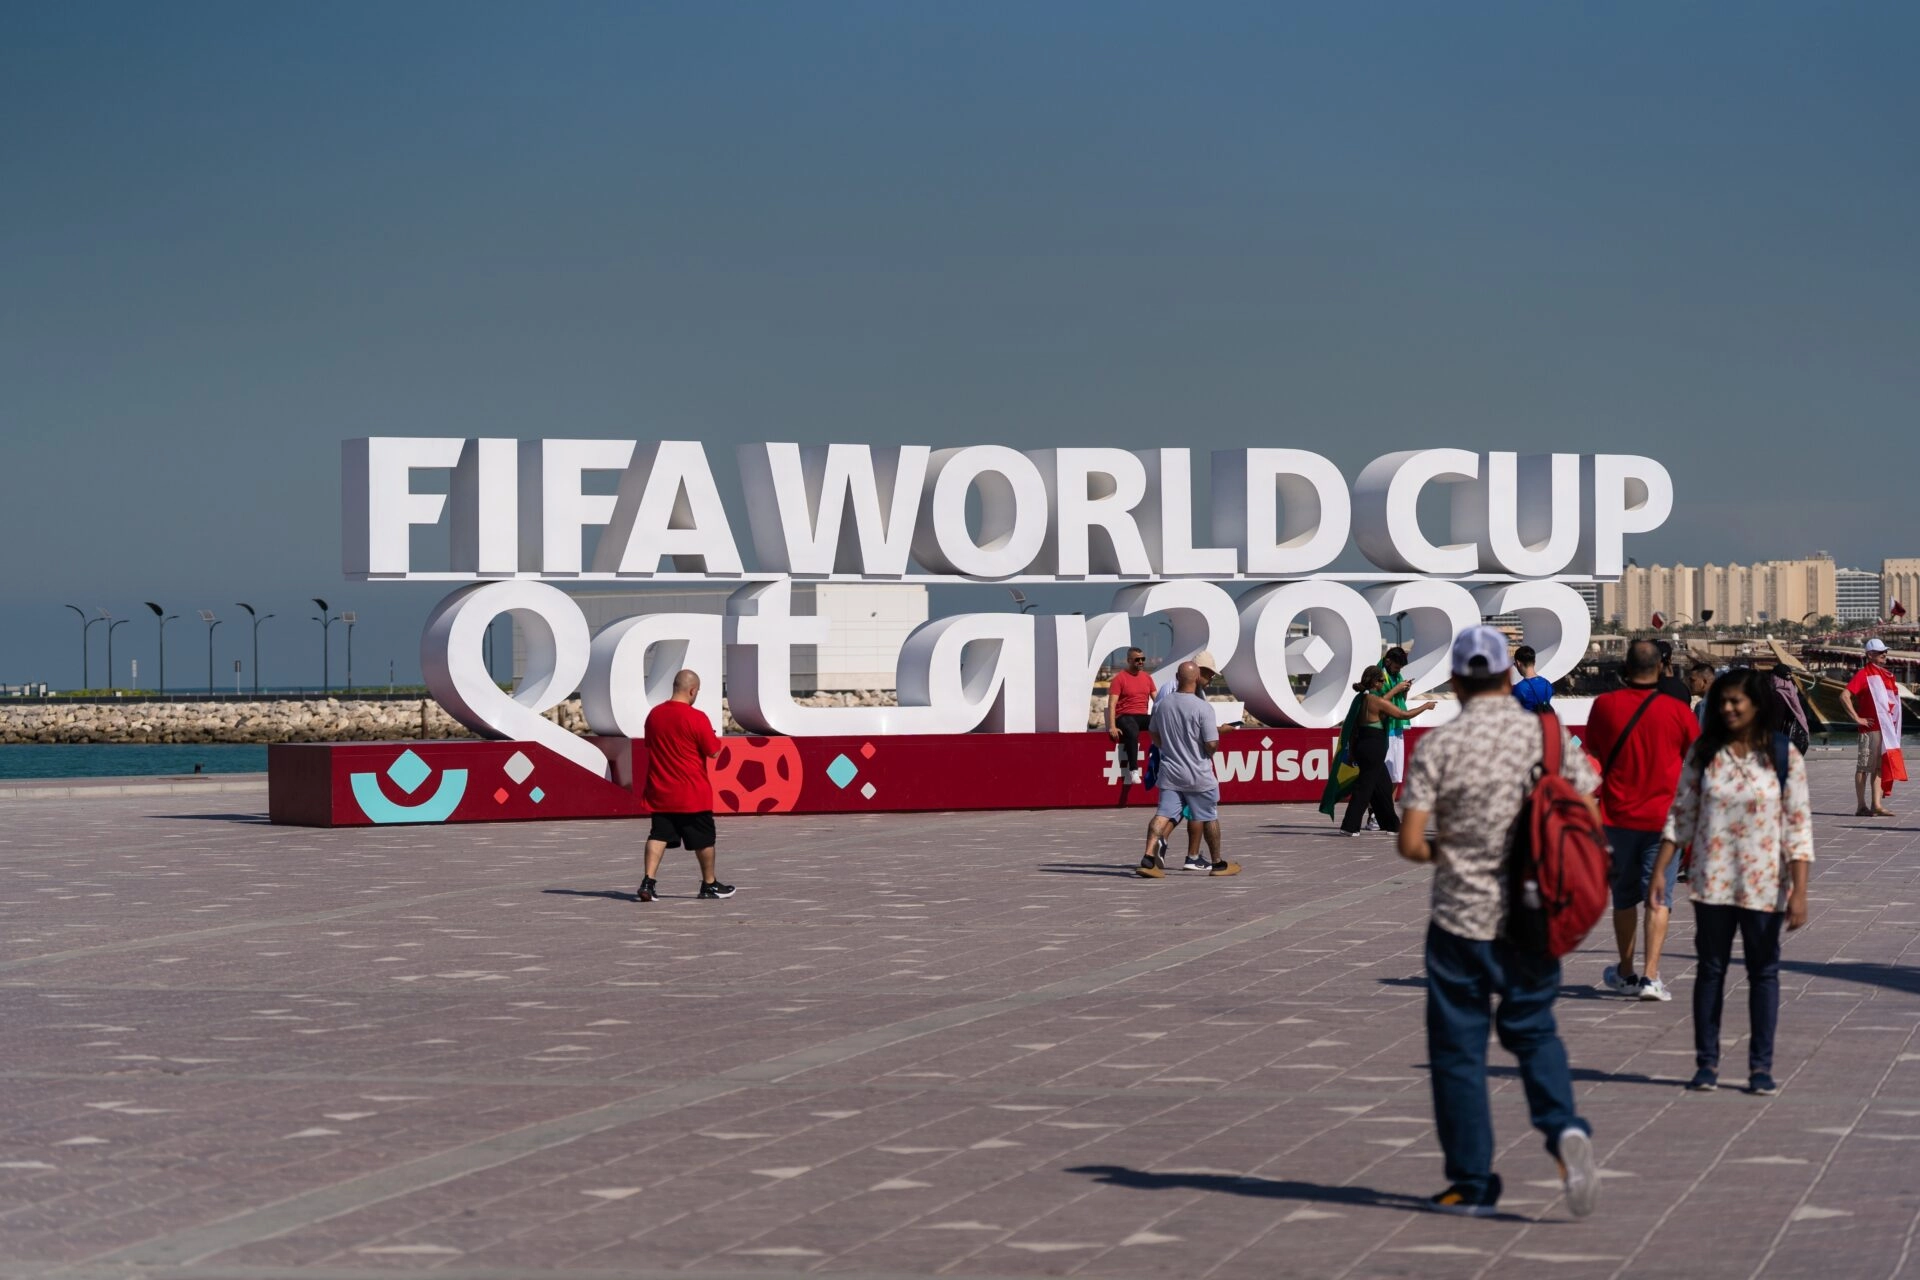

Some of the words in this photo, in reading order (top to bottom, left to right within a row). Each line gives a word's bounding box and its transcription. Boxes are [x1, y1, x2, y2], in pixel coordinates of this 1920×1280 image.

[366, 437, 745, 575] FIFA
[764, 441, 1351, 578] WORLD
[1382, 447, 1673, 577] CUP
